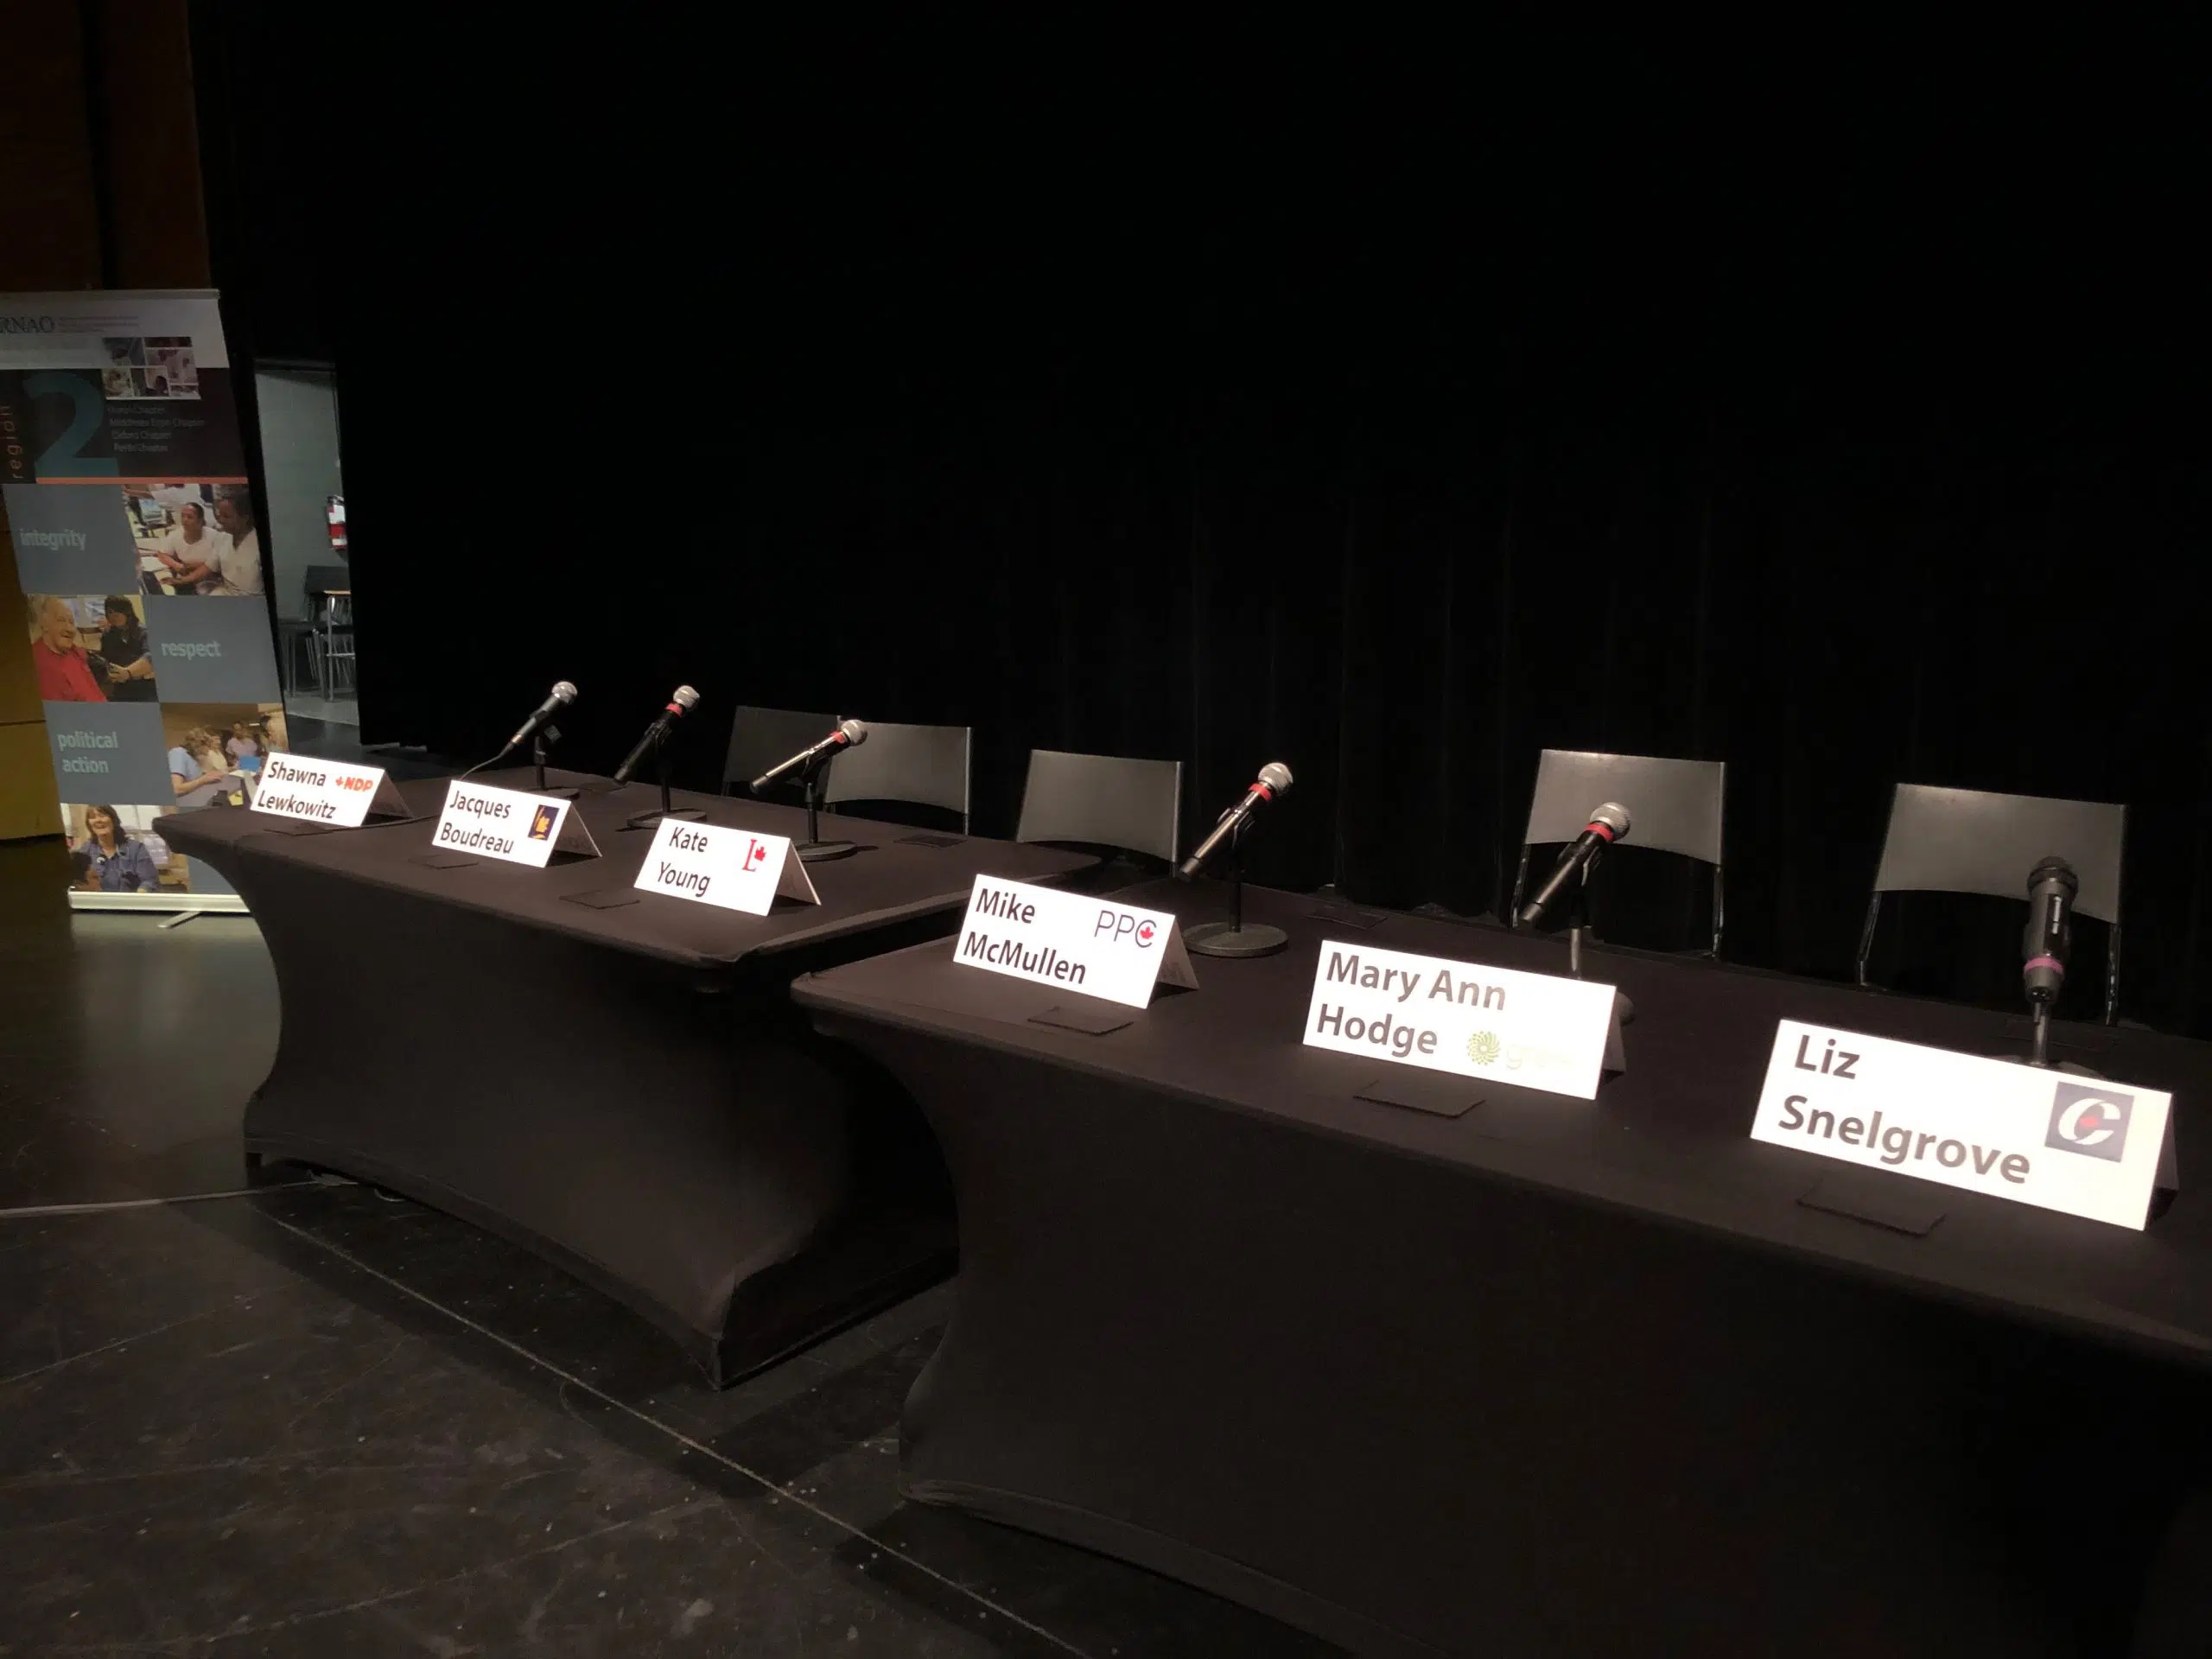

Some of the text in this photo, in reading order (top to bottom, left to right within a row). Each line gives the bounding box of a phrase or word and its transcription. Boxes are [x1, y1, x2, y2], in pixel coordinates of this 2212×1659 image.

[22, 372, 119, 476] 2
[20, 528, 86, 550] integrity
[161, 639, 222, 661] respect
[57, 731, 118, 752] political
[61, 756, 110, 773] action
[267, 760, 327, 787] Shawna
[345, 779, 374, 793] NDP
[257, 790, 337, 819] Lewkowitz
[449, 791, 512, 820] Jacques
[440, 823, 515, 855] Boudreau
[669, 827, 709, 853] Kate
[658, 861, 710, 897] Young
[975, 888, 1036, 925] Mike
[1094, 910, 1158, 949] PPC
[963, 931, 1088, 984] McMullen
[1326, 951, 1506, 1010] Mary Ann
[1317, 1003, 1438, 1058] Hodge
[1794, 1034, 1860, 1079] Liz
[1778, 1095, 2031, 1184] Snelgrove
